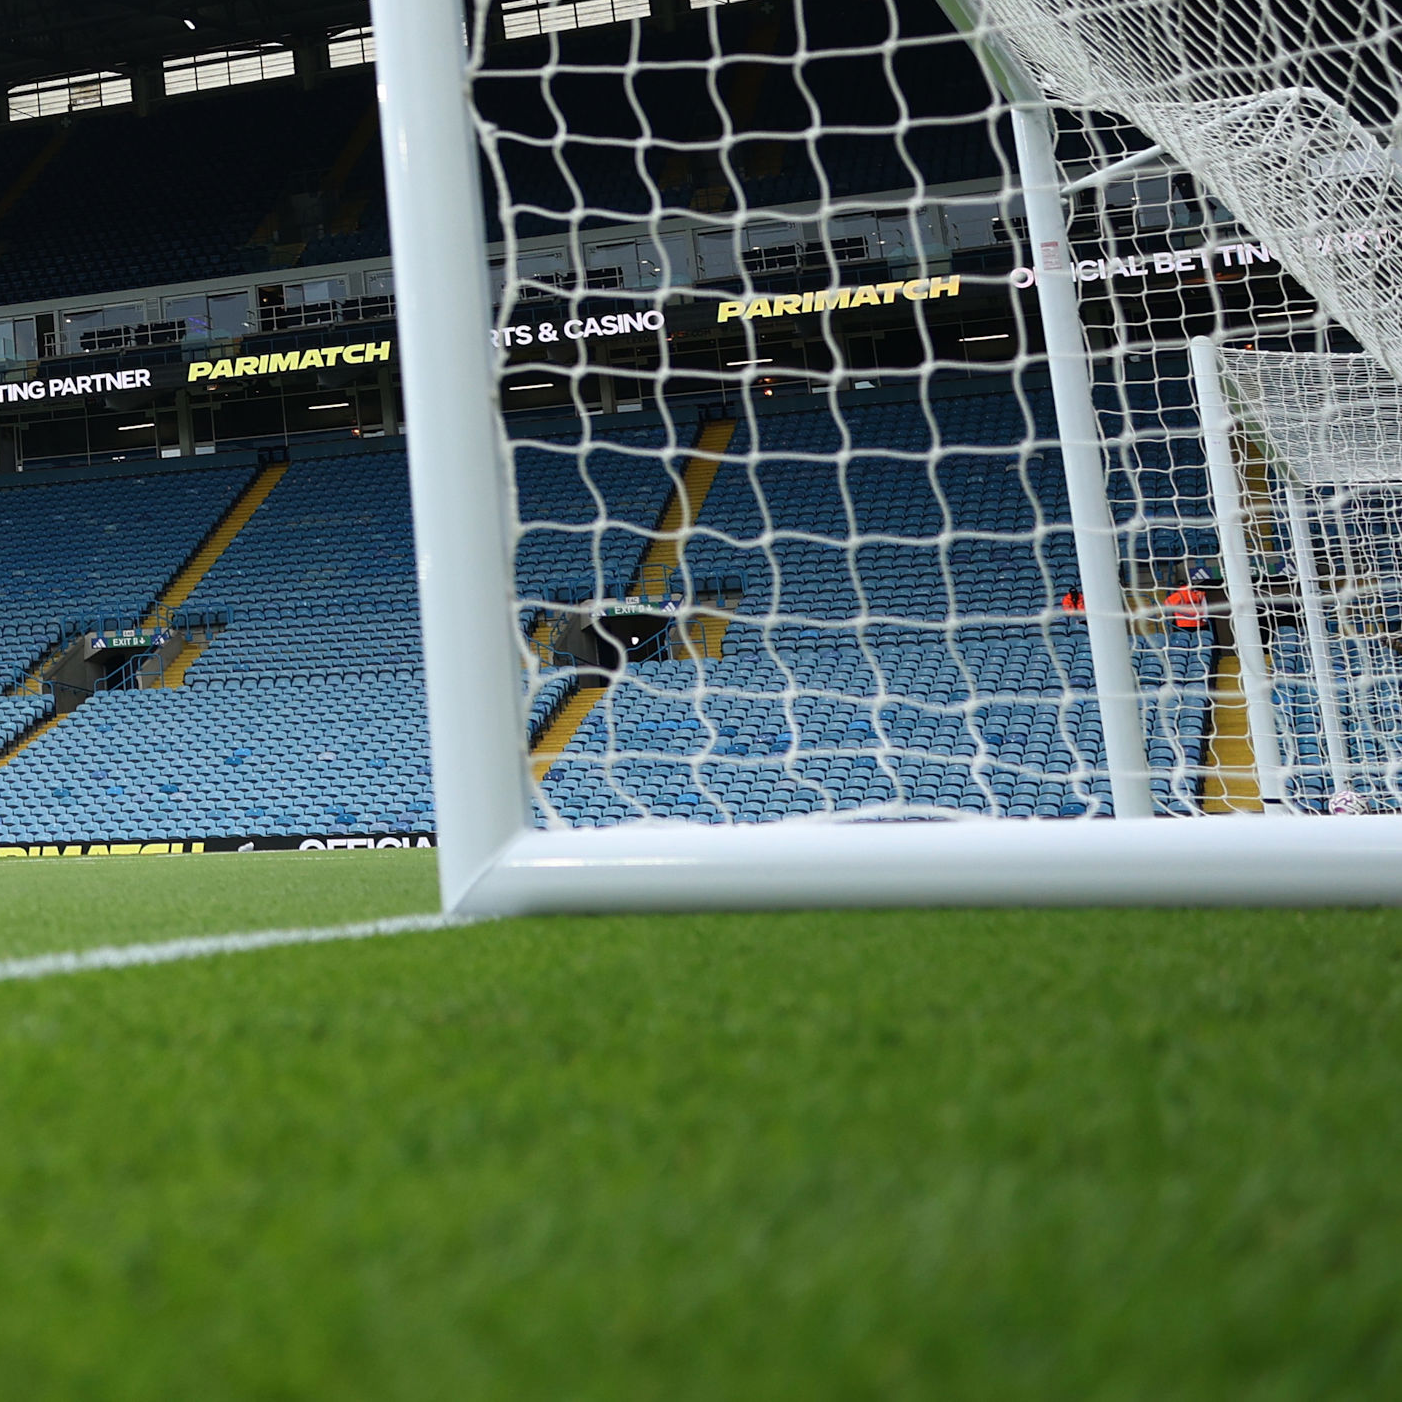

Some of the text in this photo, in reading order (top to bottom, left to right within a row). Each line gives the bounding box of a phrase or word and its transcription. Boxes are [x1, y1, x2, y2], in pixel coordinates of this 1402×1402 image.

[716, 275, 961, 324] PARIMATCH
[538, 322, 559, 343] &
[563, 310, 665, 340] CASINO
[187, 341, 391, 382] PARIMATCH
[49, 368, 151, 398] PARTNER
[112, 638, 131, 646] EXIT
